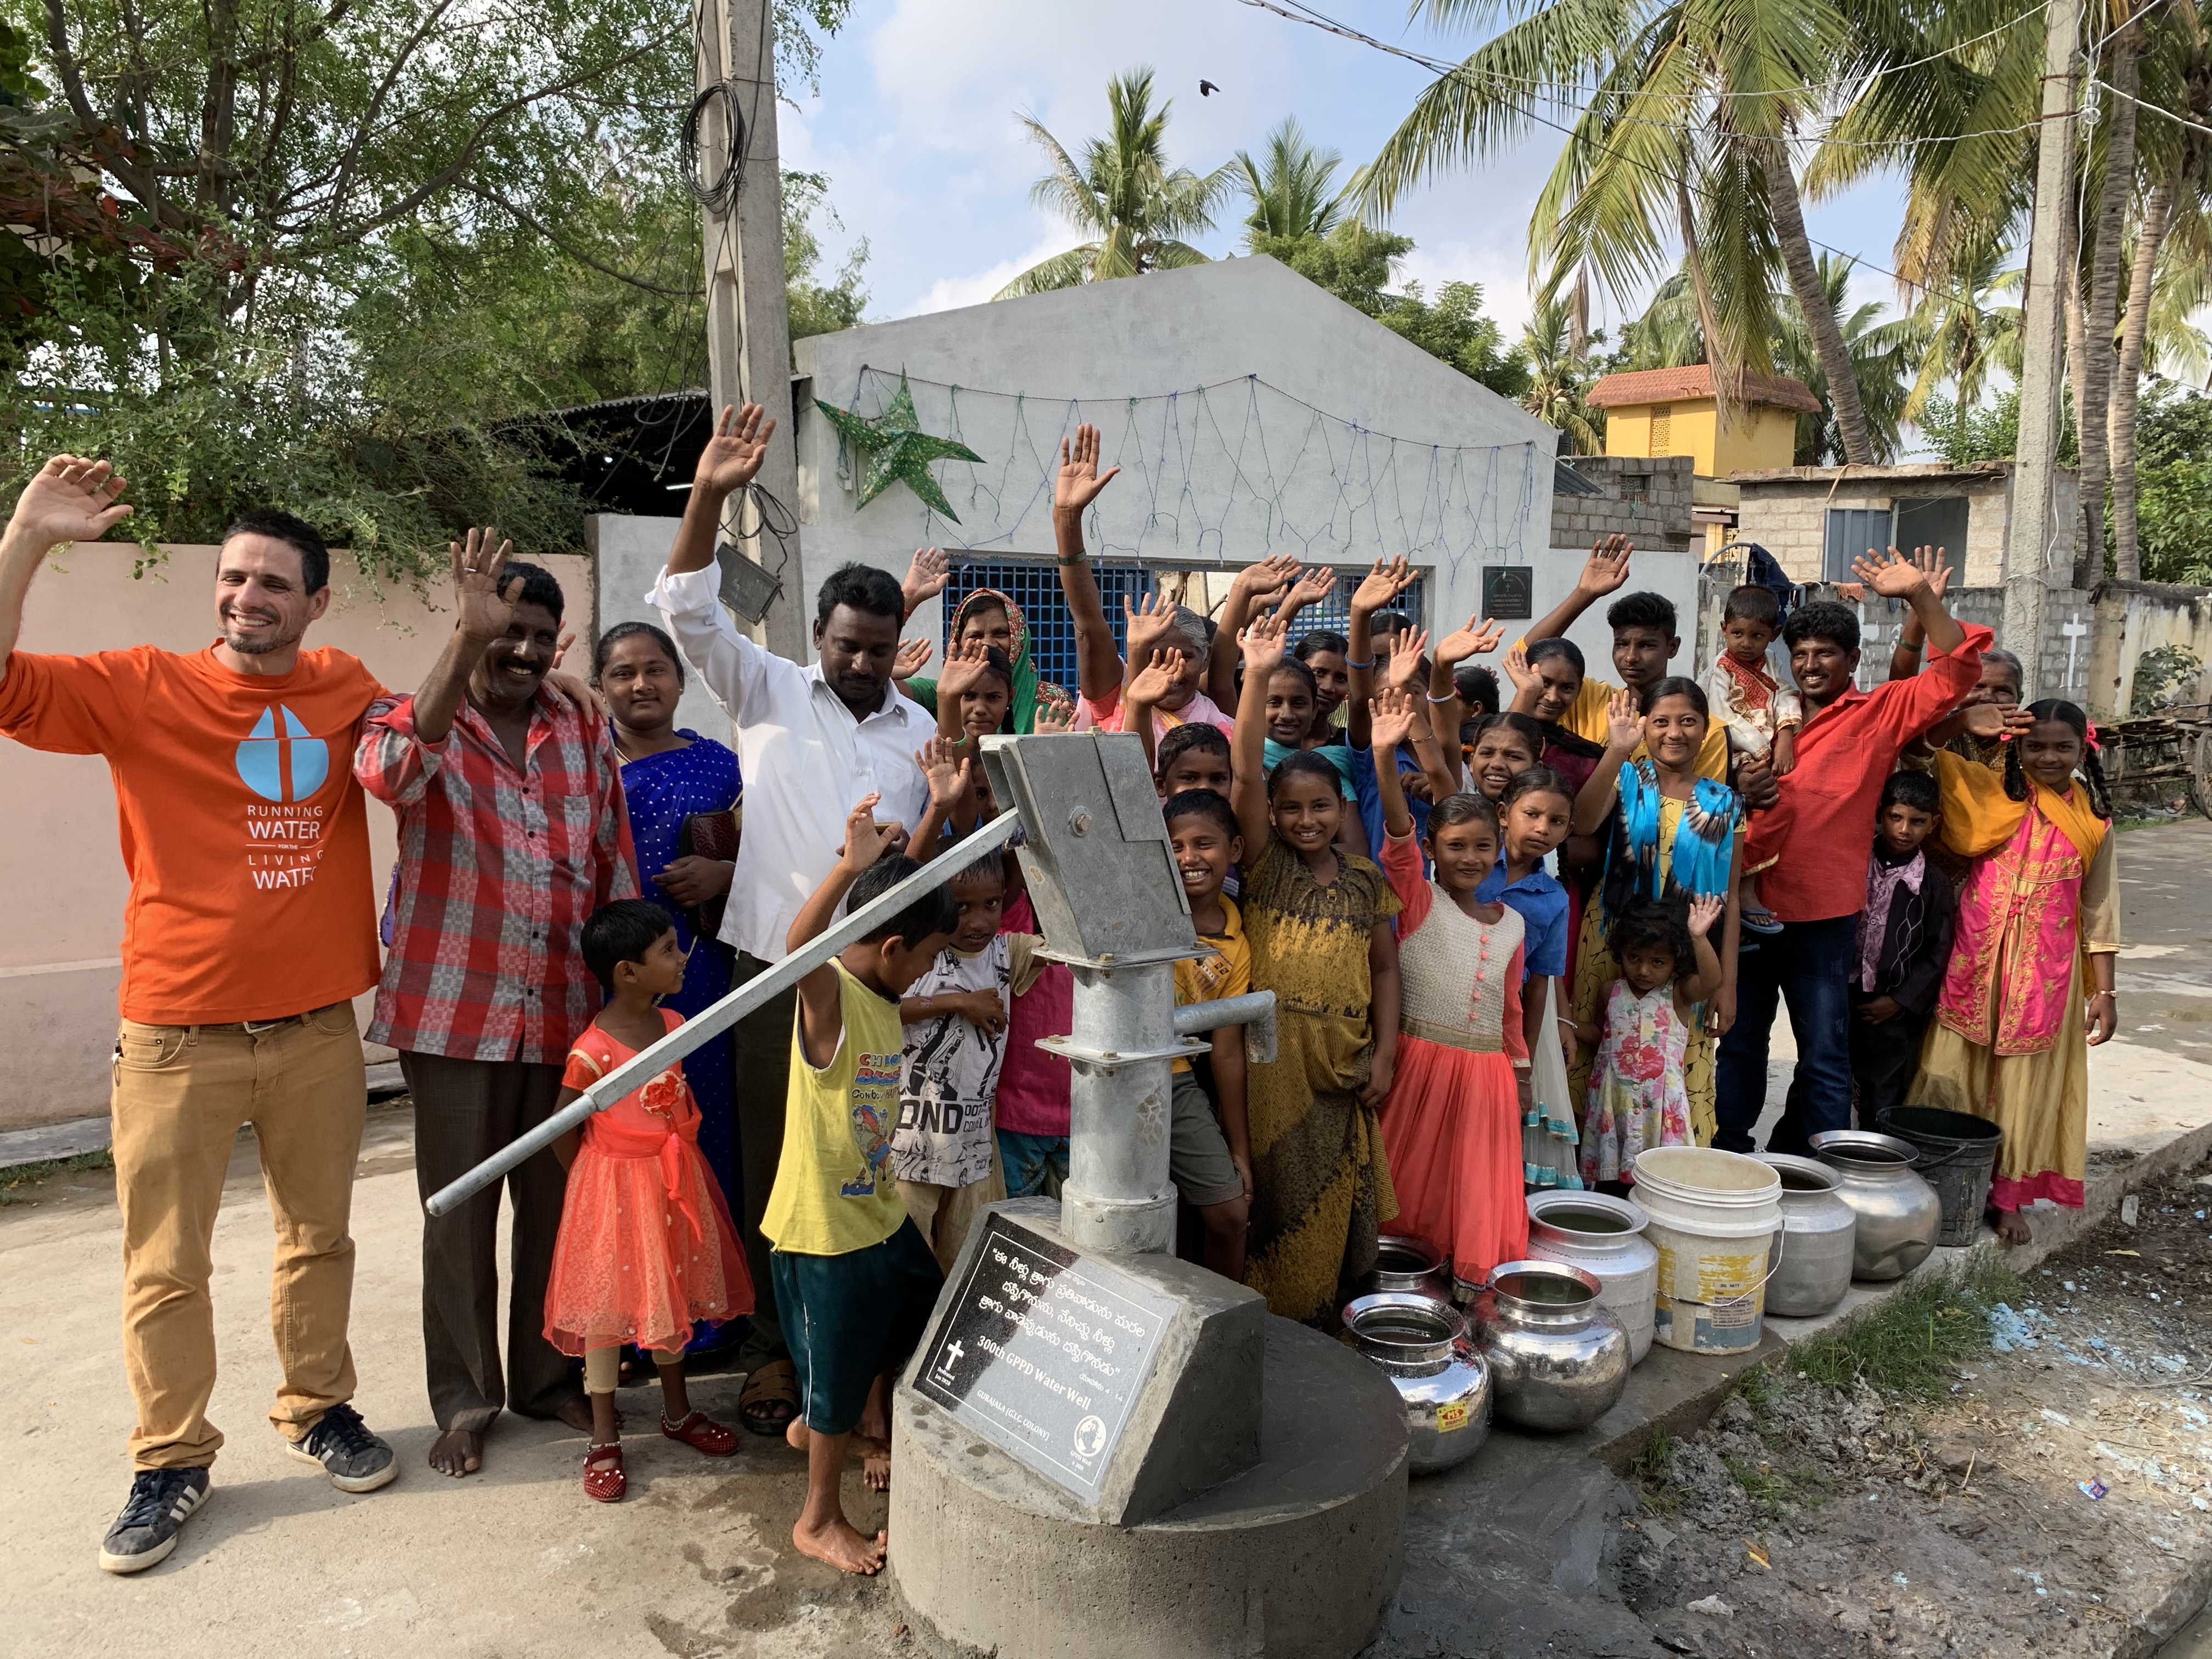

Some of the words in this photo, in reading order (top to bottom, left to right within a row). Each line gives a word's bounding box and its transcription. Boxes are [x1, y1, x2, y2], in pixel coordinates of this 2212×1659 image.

[247, 805, 323, 817] RUNNING
[247, 821, 320, 839] WATER
[249, 850, 324, 866] LIVING
[851, 1088, 883, 1102] Cowboy
[895, 1099, 963, 1134] OND
[965, 1104, 982, 1116] 007
[1114, 1314, 1145, 1336] మరల
[937, 1366, 955, 1380] Dedicated
[977, 1335, 1005, 1359] 300th
[1006, 1352, 1034, 1374] GPPD
[1035, 1368, 1065, 1394] Water
[1066, 1386, 1091, 1410] Well
[977, 1389, 1005, 1412] GURAJALA
[1023, 1418, 1049, 1441] COLONY)
[1448, 1409, 1460, 1419] MS
[1445, 1417, 1463, 1426] BRAND
[1082, 1457, 1092, 1466] Well
